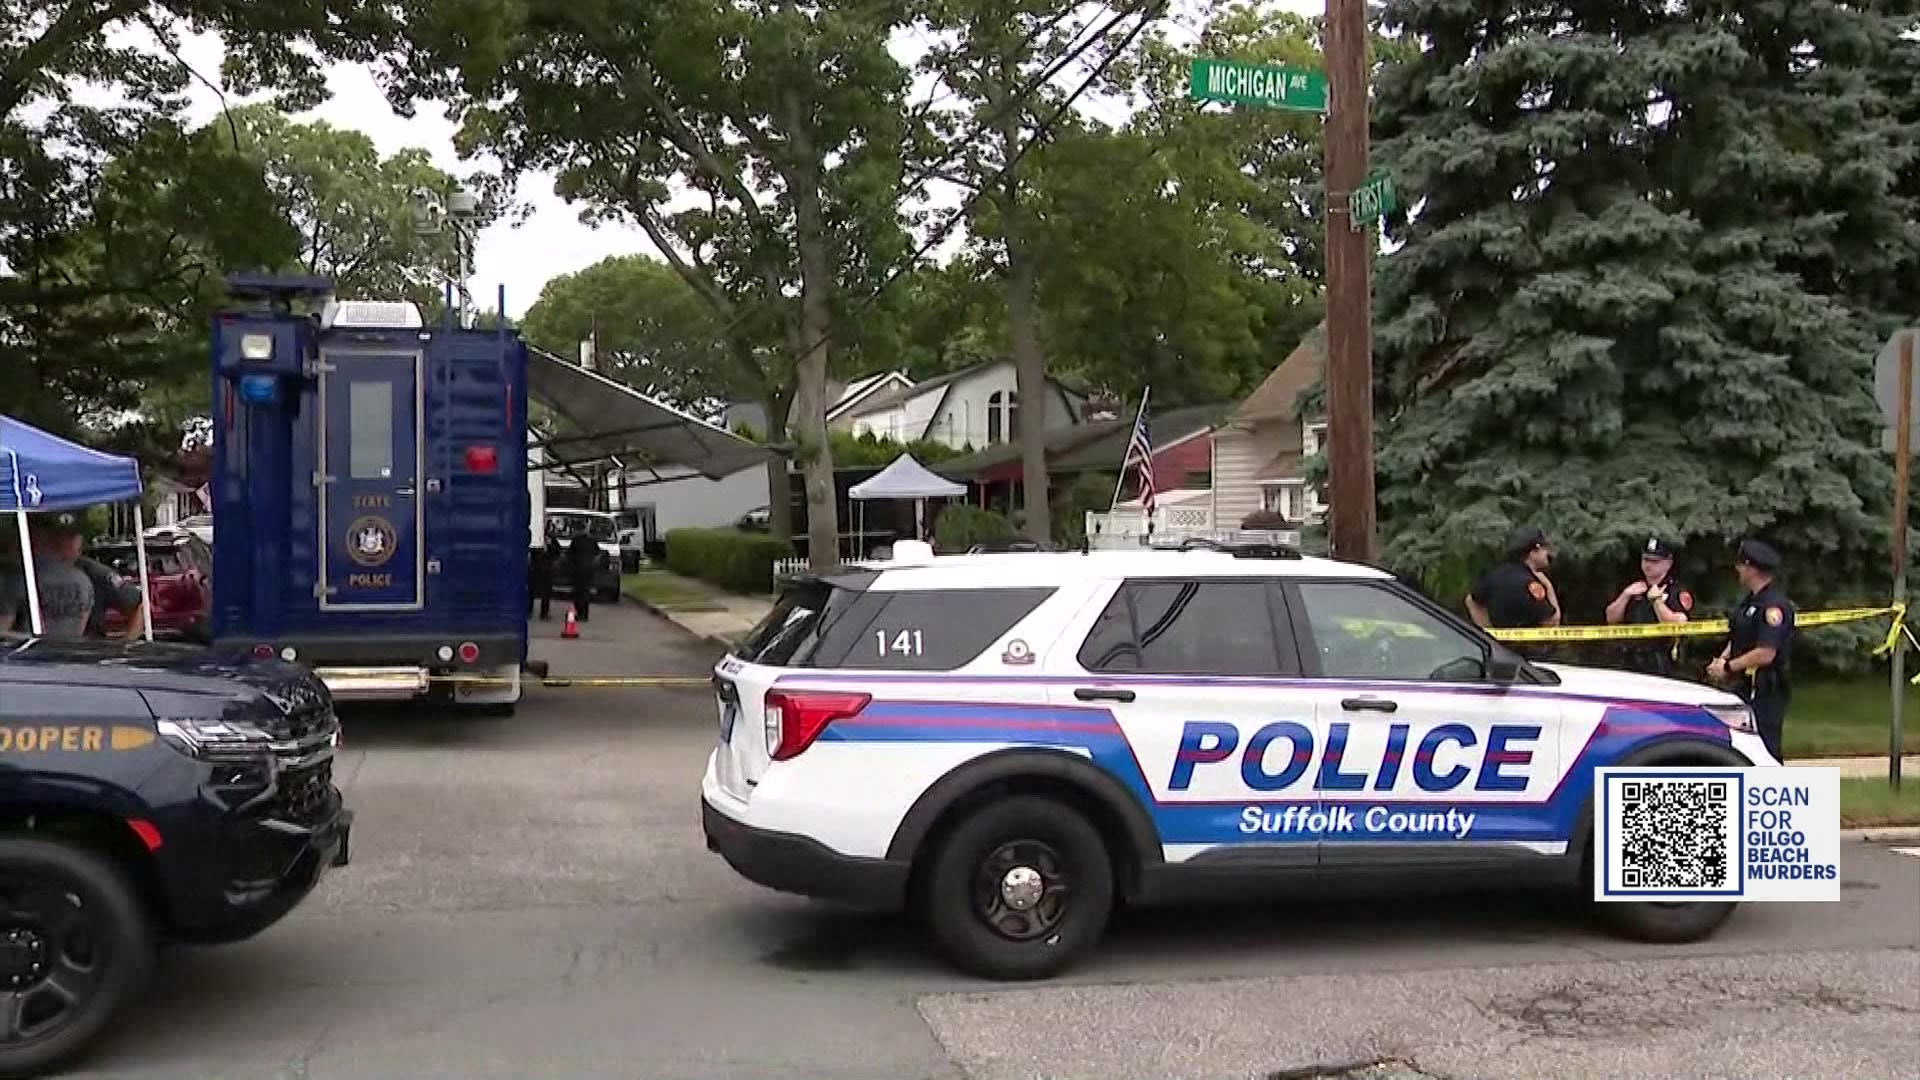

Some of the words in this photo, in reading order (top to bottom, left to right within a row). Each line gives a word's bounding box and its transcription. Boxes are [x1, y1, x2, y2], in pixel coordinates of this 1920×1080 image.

[1208, 65, 1287, 100] MICHIGAN
[1289, 75, 1308, 91] AVE
[352, 495, 391, 508] STATE
[349, 573, 392, 587] POLICE
[876, 629, 924, 657] 141
[1168, 720, 1542, 793] POLICE
[1239, 806, 1355, 834] Suffolk
[1365, 806, 1475, 840] County
